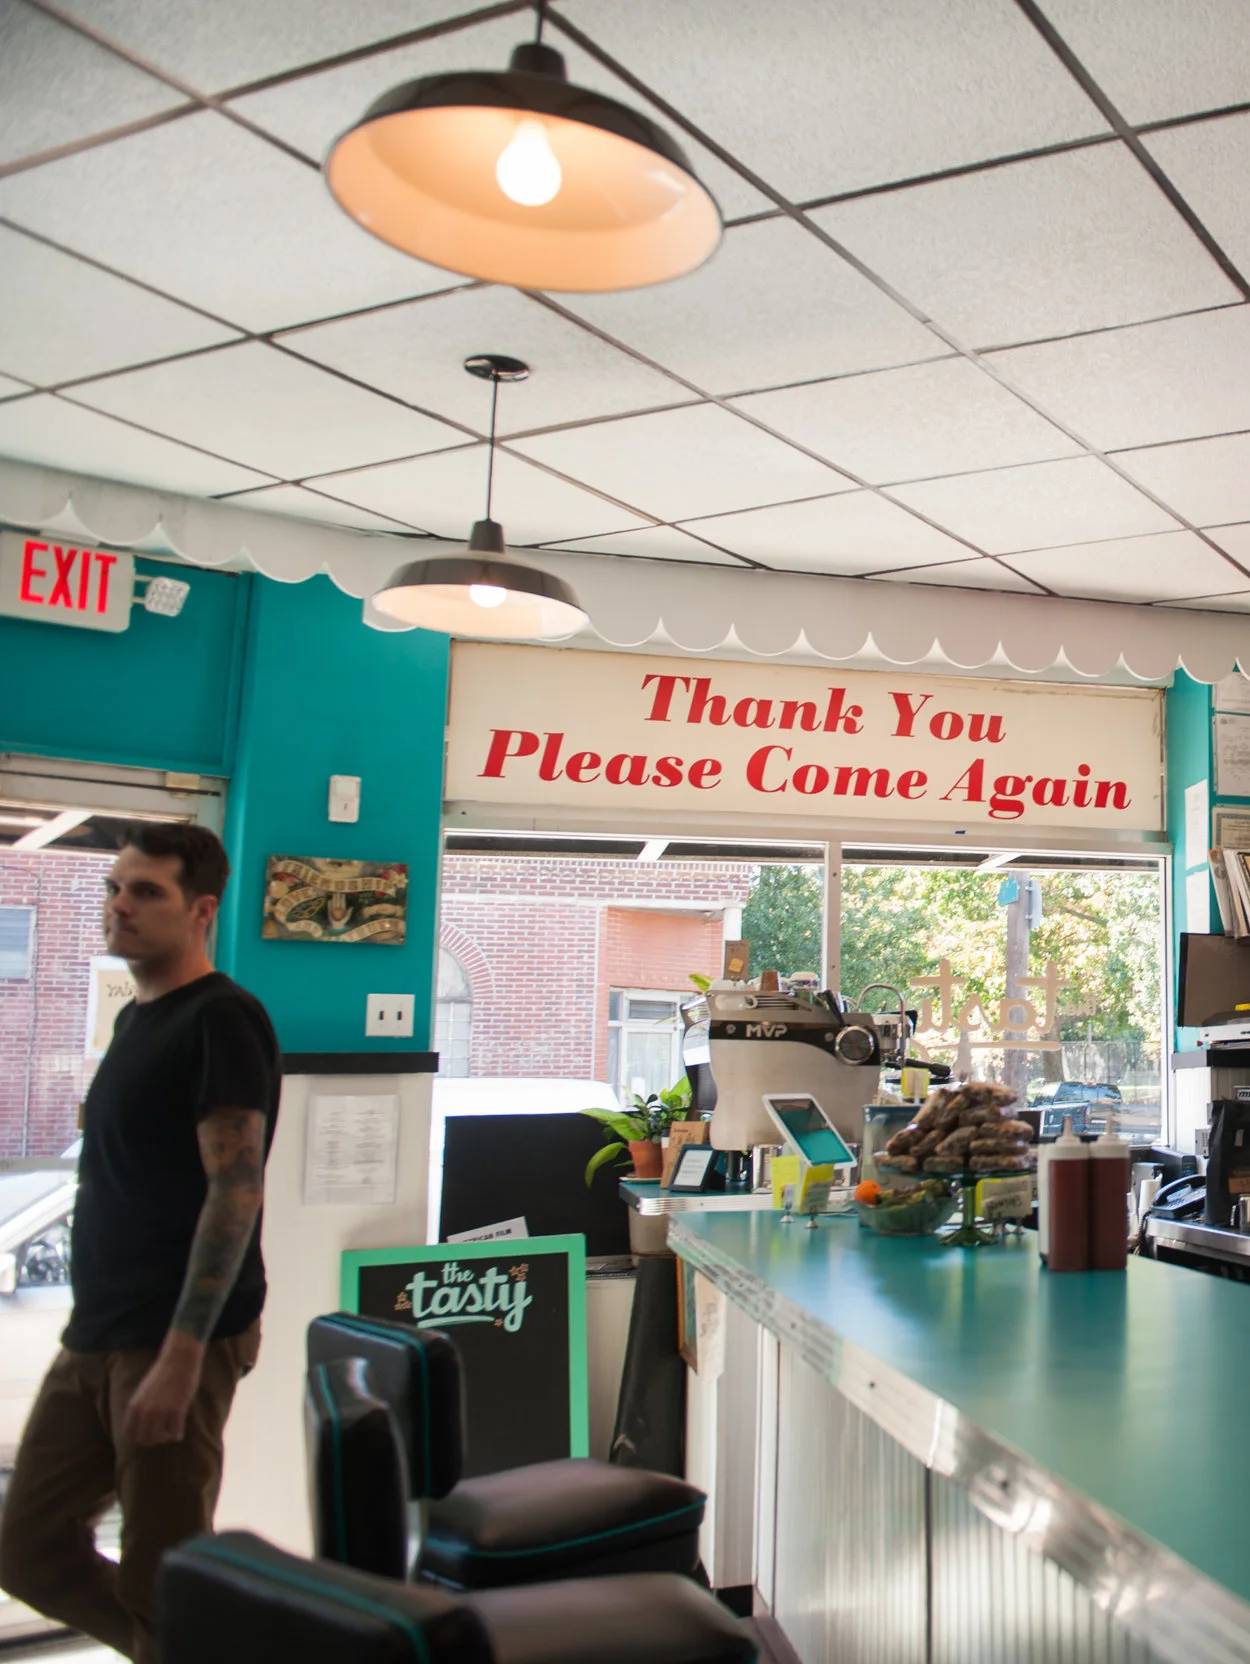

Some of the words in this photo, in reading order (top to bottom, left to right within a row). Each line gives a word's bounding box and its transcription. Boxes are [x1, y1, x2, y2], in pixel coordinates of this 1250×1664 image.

[20, 540, 117, 615] EXIT
[641, 674, 864, 734] Thank
[887, 692, 1007, 744] You
[476, 729, 722, 790] Please
[746, 745, 928, 801] Come
[940, 758, 1132, 821] Again
[746, 1023, 787, 1038] MVP
[405, 1267, 533, 1333] tasty
[441, 1261, 474, 1285] the
